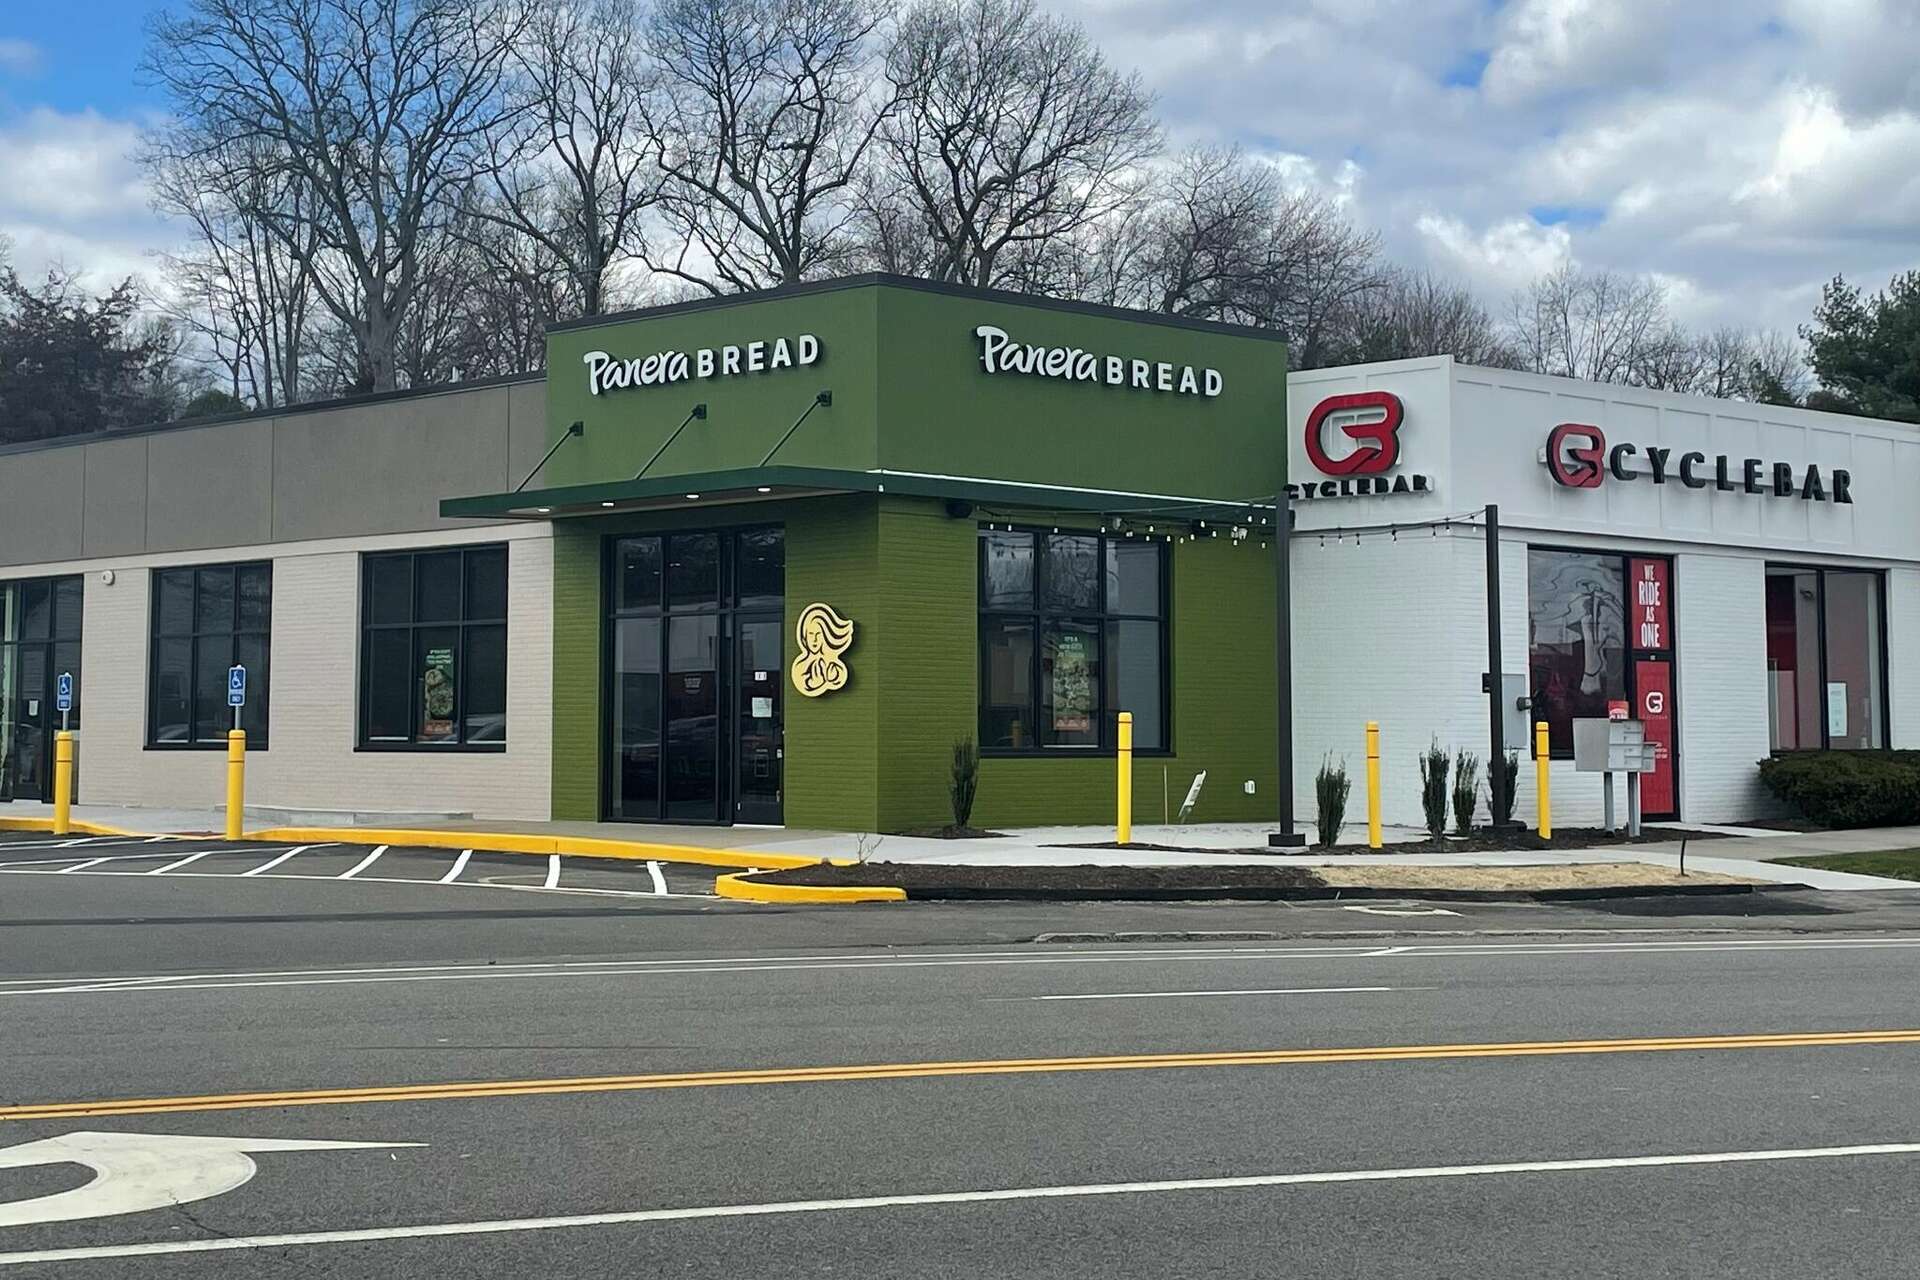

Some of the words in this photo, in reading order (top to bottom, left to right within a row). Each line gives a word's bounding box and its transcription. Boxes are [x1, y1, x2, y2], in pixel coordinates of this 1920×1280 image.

[583, 350, 689, 395] Panera
[697, 334, 819, 378] BREAD
[976, 325, 1098, 382] Panera
[1106, 355, 1223, 397] BREAD
[1609, 442, 1854, 504] CYCLEBAR
[1284, 474, 1431, 499] CYCLEBAR
[1644, 564, 1655, 581] WE
[1638, 580, 1661, 606] RIDE
[1645, 606, 1655, 622] AS
[1641, 622, 1661, 648] ONE
